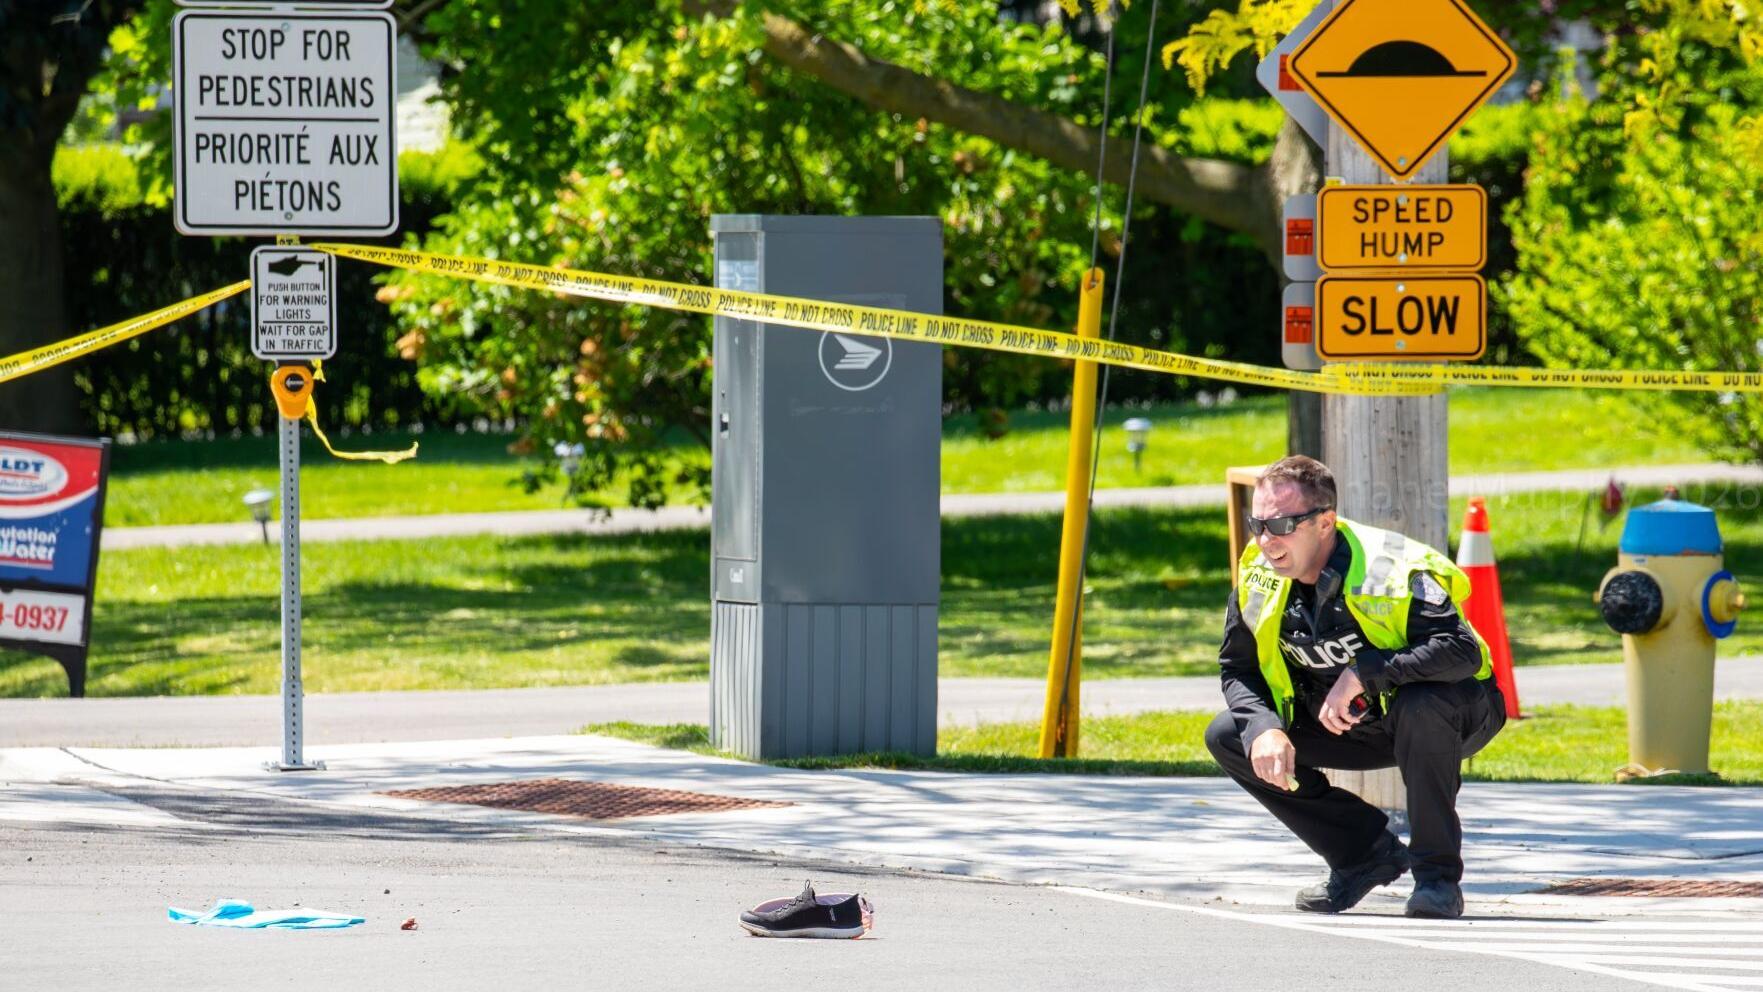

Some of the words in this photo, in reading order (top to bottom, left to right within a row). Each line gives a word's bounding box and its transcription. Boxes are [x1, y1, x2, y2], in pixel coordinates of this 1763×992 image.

[221, 28, 285, 60] STOP
[303, 30, 351, 61] FOR
[199, 75, 375, 108] PEDESTRIANS
[195, 125, 311, 165] PRIORITÉ
[329, 135, 379, 165] AUX
[234, 171, 342, 211] PIÉTONS
[1352, 197, 1454, 224] SPEED
[1360, 232, 1445, 258] HUMP
[268, 282, 288, 291] PUSH
[290, 282, 320, 291] BUTTON
[259, 295, 279, 306] FOR
[282, 295, 327, 306] WARNING
[275, 309, 311, 320] LIGHTS
[513, 267, 533, 281] NOT
[677, 289, 712, 308] CROSS
[716, 294, 752, 313] POLICE
[753, 298, 777, 317] LINE
[784, 303, 796, 320] DO
[800, 304, 820, 322] NOT
[822, 307, 854, 327] CROSS
[859, 311, 895, 332] POLICE
[895, 317, 918, 335] LINE
[925, 319, 939, 337] DO
[941, 321, 960, 340] NOT
[961, 323, 994, 344] CROSS
[1000, 330, 1035, 349] POLICE
[1036, 333, 1058, 351] LINE
[1065, 337, 1081, 353] DO
[1081, 340, 1101, 357] NOT
[1102, 343, 1135, 361] CROSS
[1142, 352, 1175, 368] POLICE
[1177, 358, 1199, 371] LINE
[1341, 295, 1460, 336] SLOW
[259, 325, 283, 336] WAIT
[286, 325, 305, 336] FOR
[309, 325, 329, 336] GAP
[265, 339, 275, 350] IN
[282, 339, 323, 350] TRAFFIC
